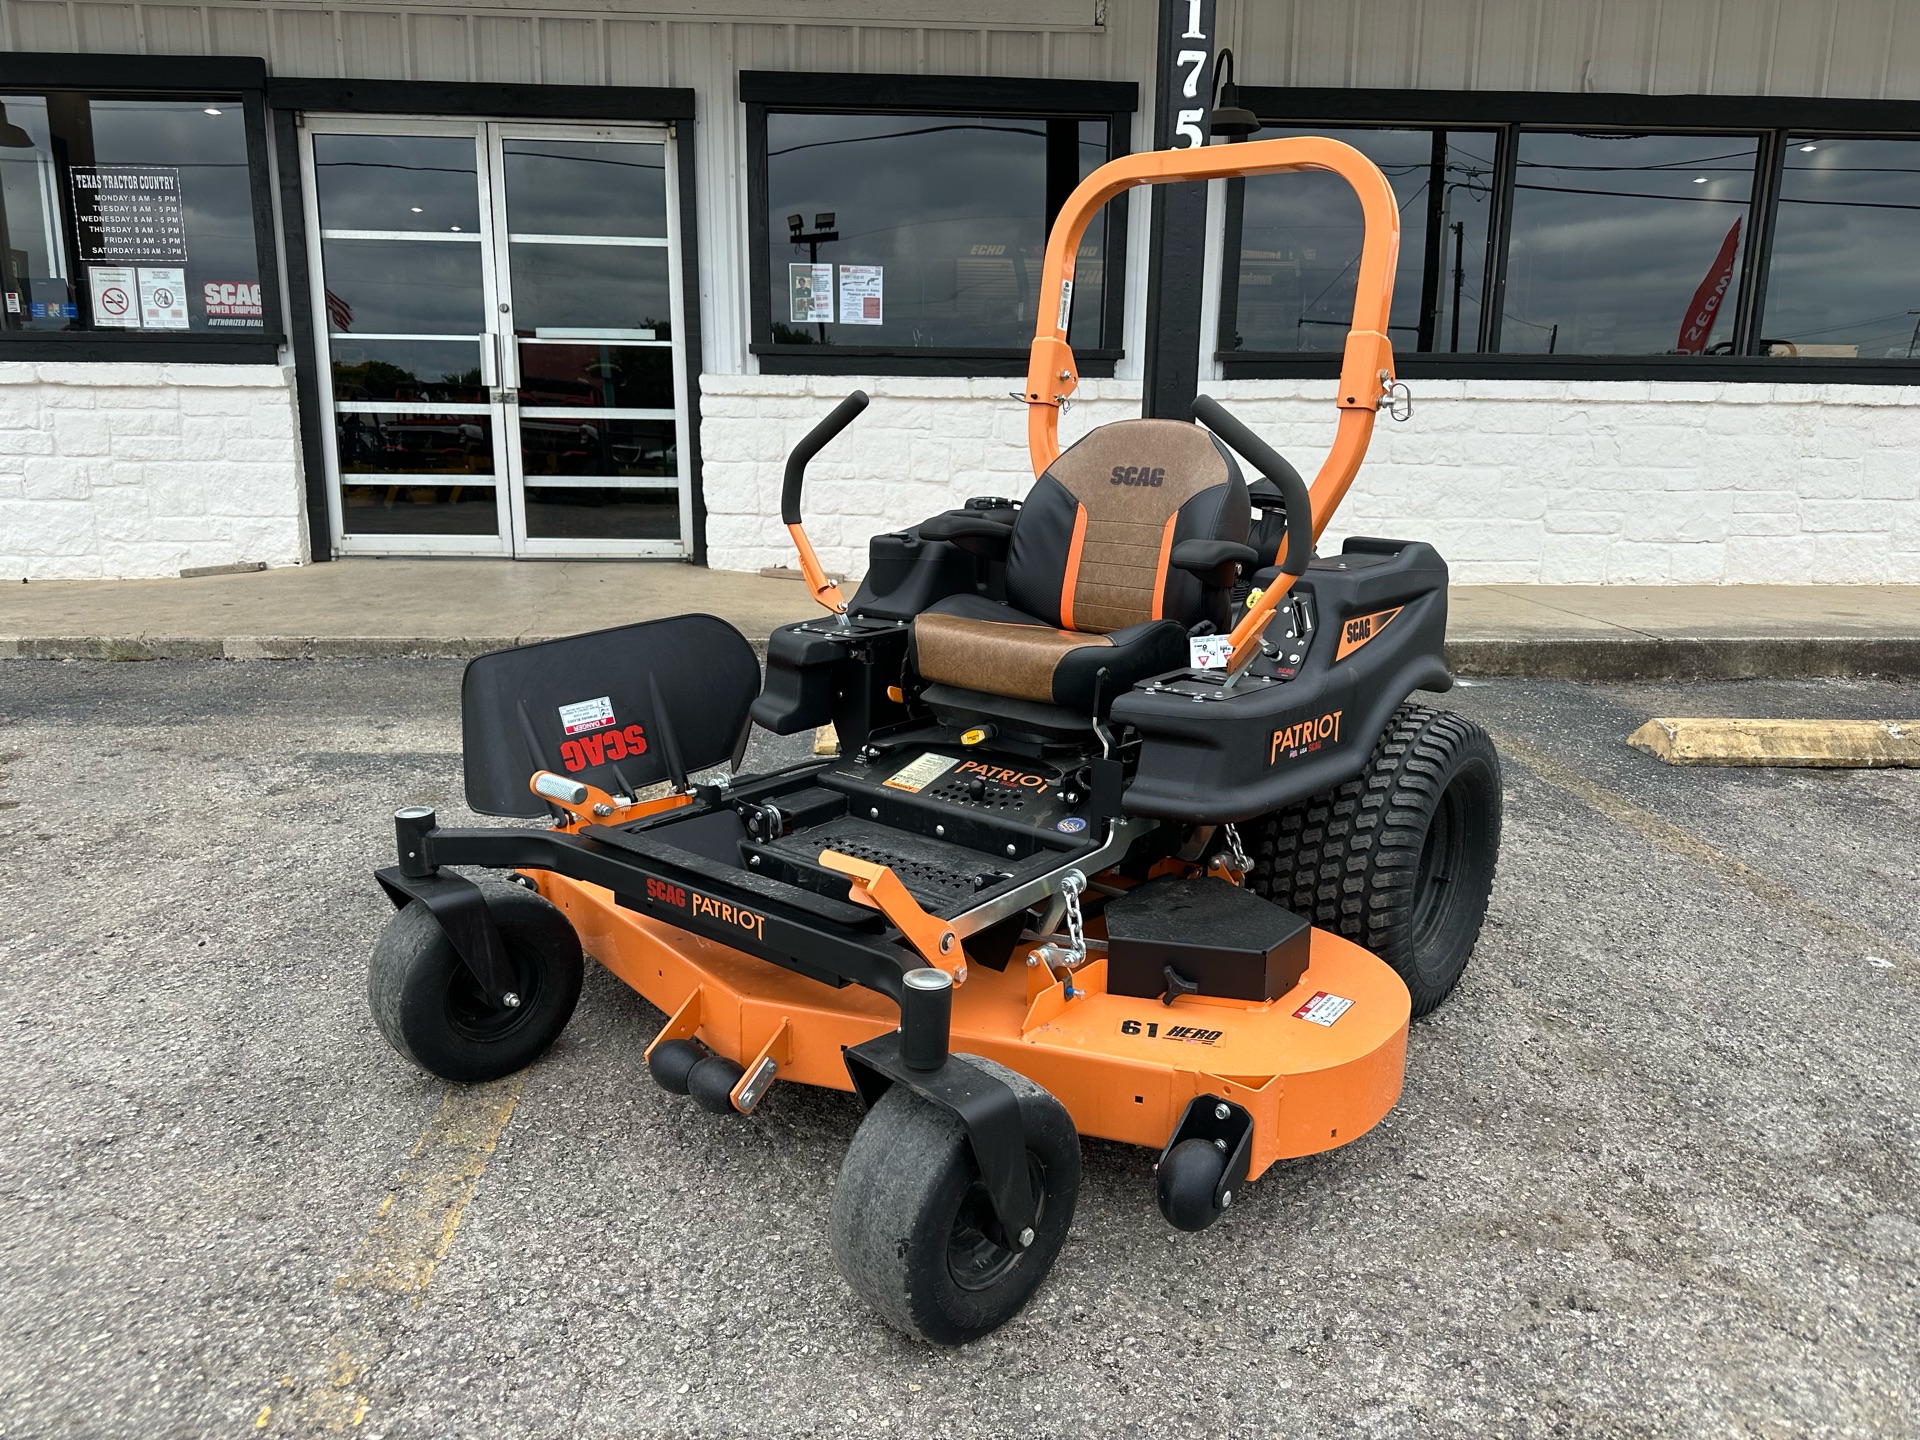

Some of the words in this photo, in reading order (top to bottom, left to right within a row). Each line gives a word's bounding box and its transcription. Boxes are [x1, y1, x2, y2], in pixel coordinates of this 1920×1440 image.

[76, 175, 101, 189] TEXAS
[103, 175, 138, 189] TRACTOR
[139, 176, 174, 190] COUNTRY
[164, 195, 177, 203] PM
[134, 226, 140, 234] 8
[970, 245, 1006, 255] ECHO
[204, 283, 262, 306] SCAG
[206, 305, 230, 314] POWER
[208, 318, 246, 326] AUTHORIZED
[1110, 466, 1166, 487] SCAG
[1347, 618, 1370, 644] SCAG
[574, 720, 600, 732] DANGER
[560, 724, 648, 772] SCAG
[1271, 710, 1342, 765] PATRIOT
[954, 760, 1050, 793] PATRIOT
[646, 877, 686, 908] SCAG
[692, 893, 765, 941] PATRIOT
[1121, 1019, 1159, 1038] 61
[1165, 1025, 1223, 1041] HERO
